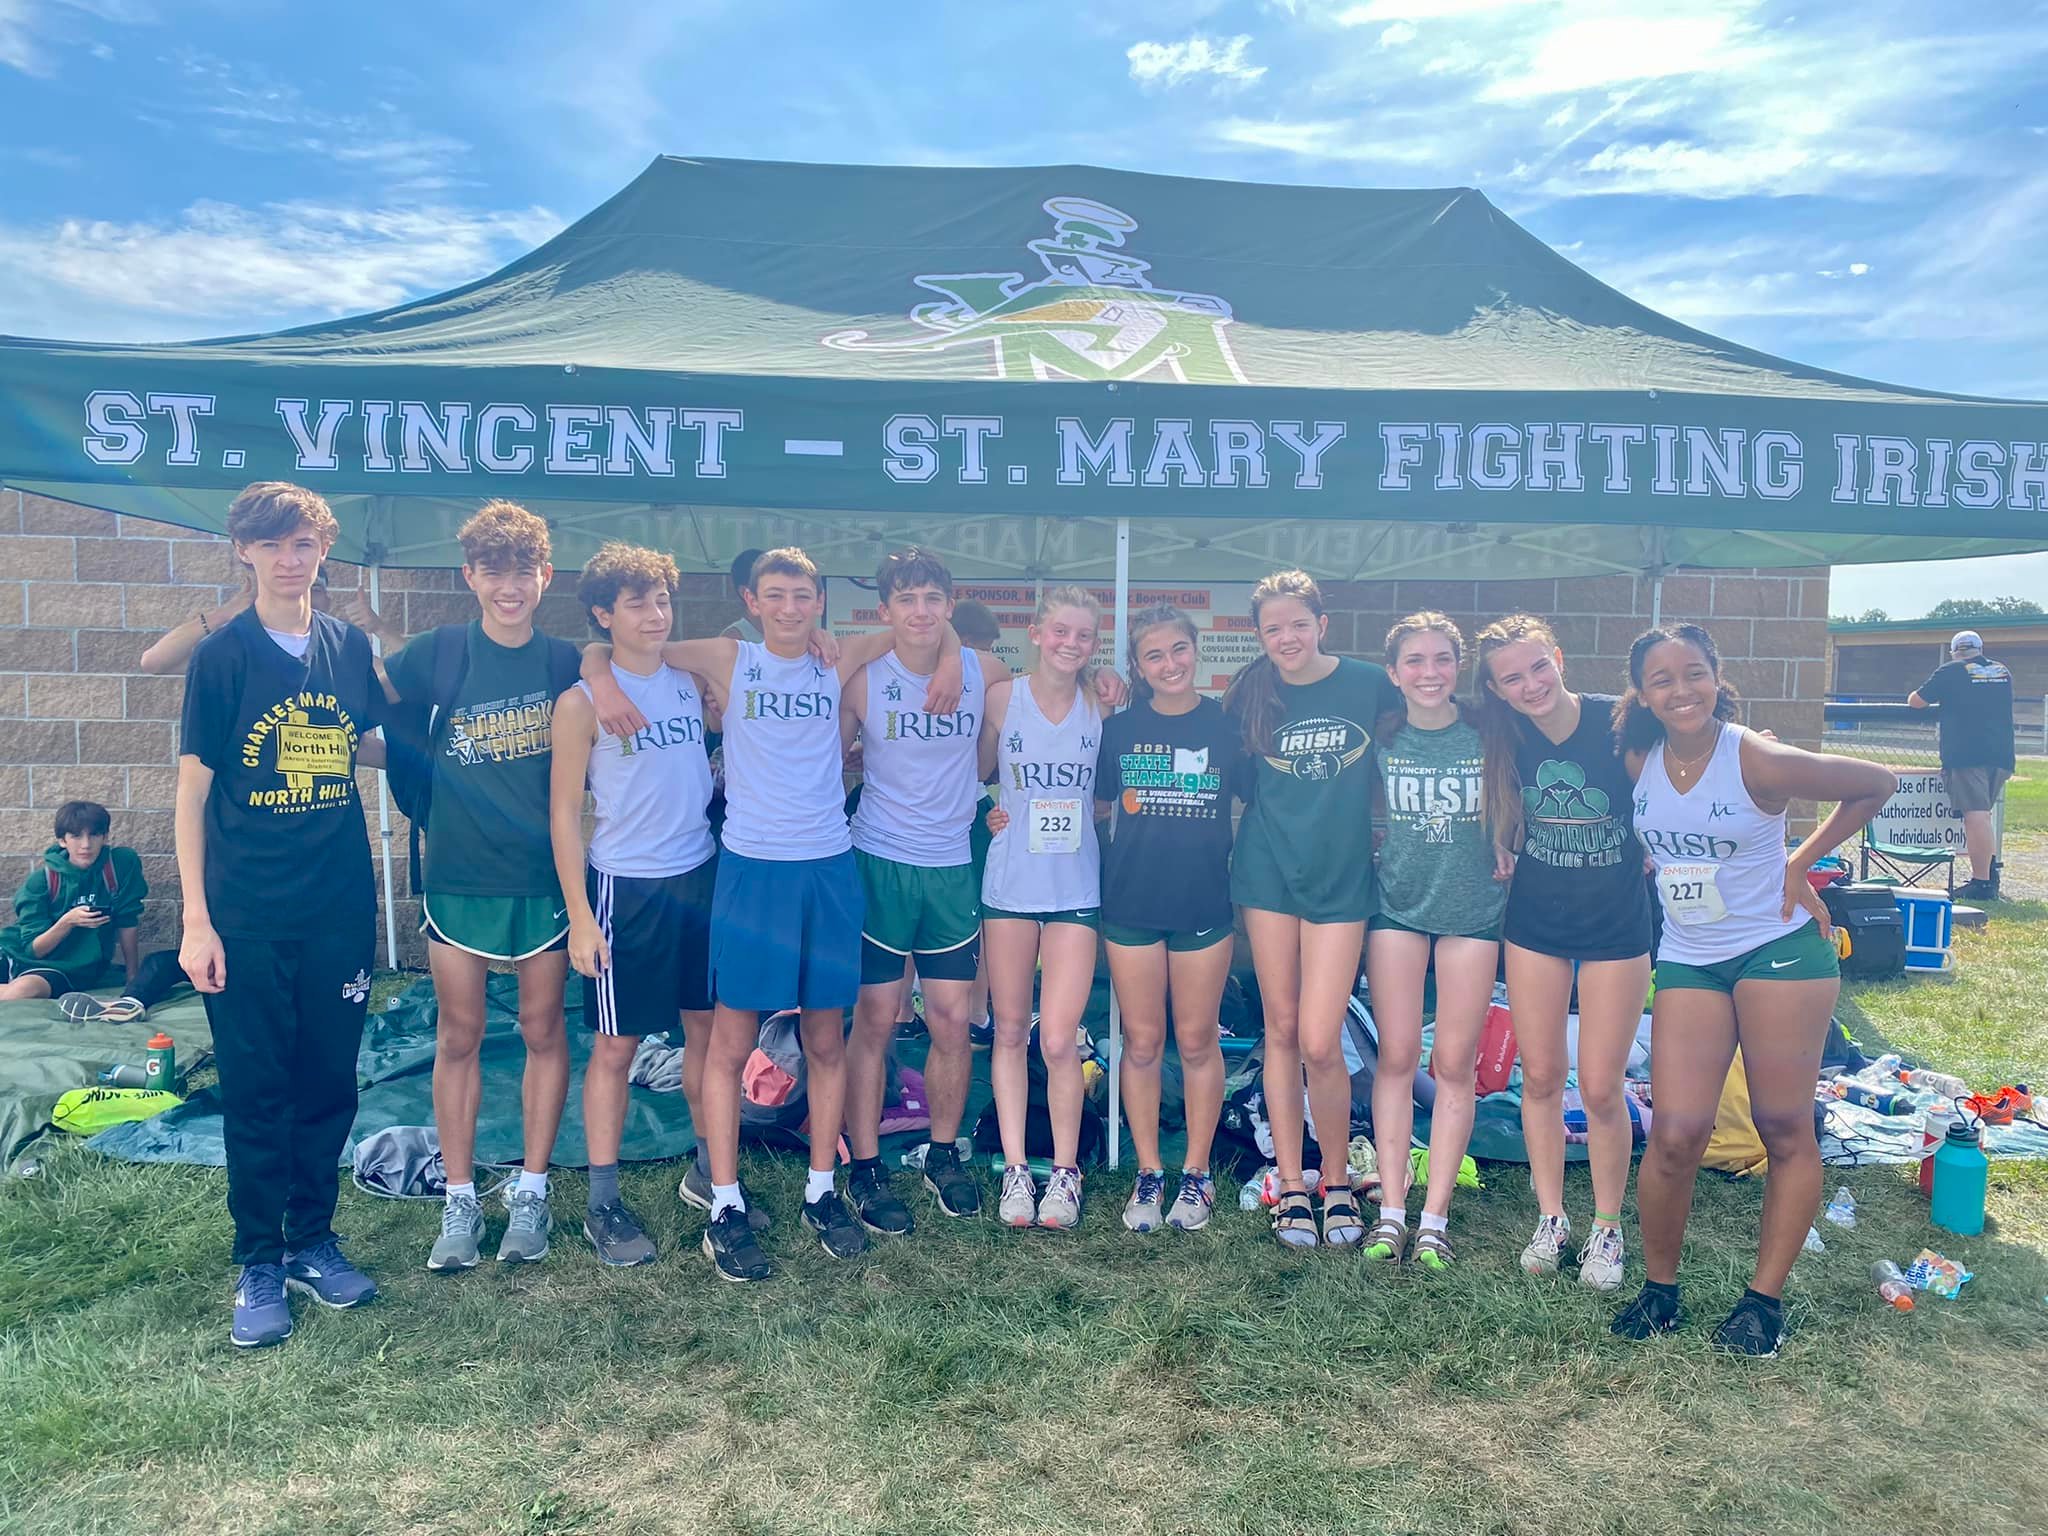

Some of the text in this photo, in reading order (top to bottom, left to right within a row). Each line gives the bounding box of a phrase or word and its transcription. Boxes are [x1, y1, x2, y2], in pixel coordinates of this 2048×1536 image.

[83, 389, 245, 469] ST.
[275, 397, 743, 477] VINCENT
[882, 413, 1027, 485] ST.
[1055, 416, 1346, 489] MARY
[1377, 421, 1804, 501] FIGHTING
[1830, 433, 2048, 511] IRISH
[1182, 592, 1206, 605] Club
[467, 699, 553, 740] TRACK
[242, 697, 298, 768] CHARLES
[288, 730, 333, 740] WELCOME
[1280, 729, 1347, 752] IRISH
[283, 741, 325, 755] North
[1133, 744, 1172, 754] 2021
[1119, 754, 1172, 770] STATE
[1387, 775, 1484, 814] IRISH
[1916, 777, 1926, 794] of
[249, 787, 313, 806] NORTH
[1875, 802, 1932, 819] Authorized
[1040, 816, 1072, 832] 232
[1889, 827, 1967, 849] Individuals Only
[1669, 881, 1703, 901] 227
[146, 1058, 160, 1076] G
